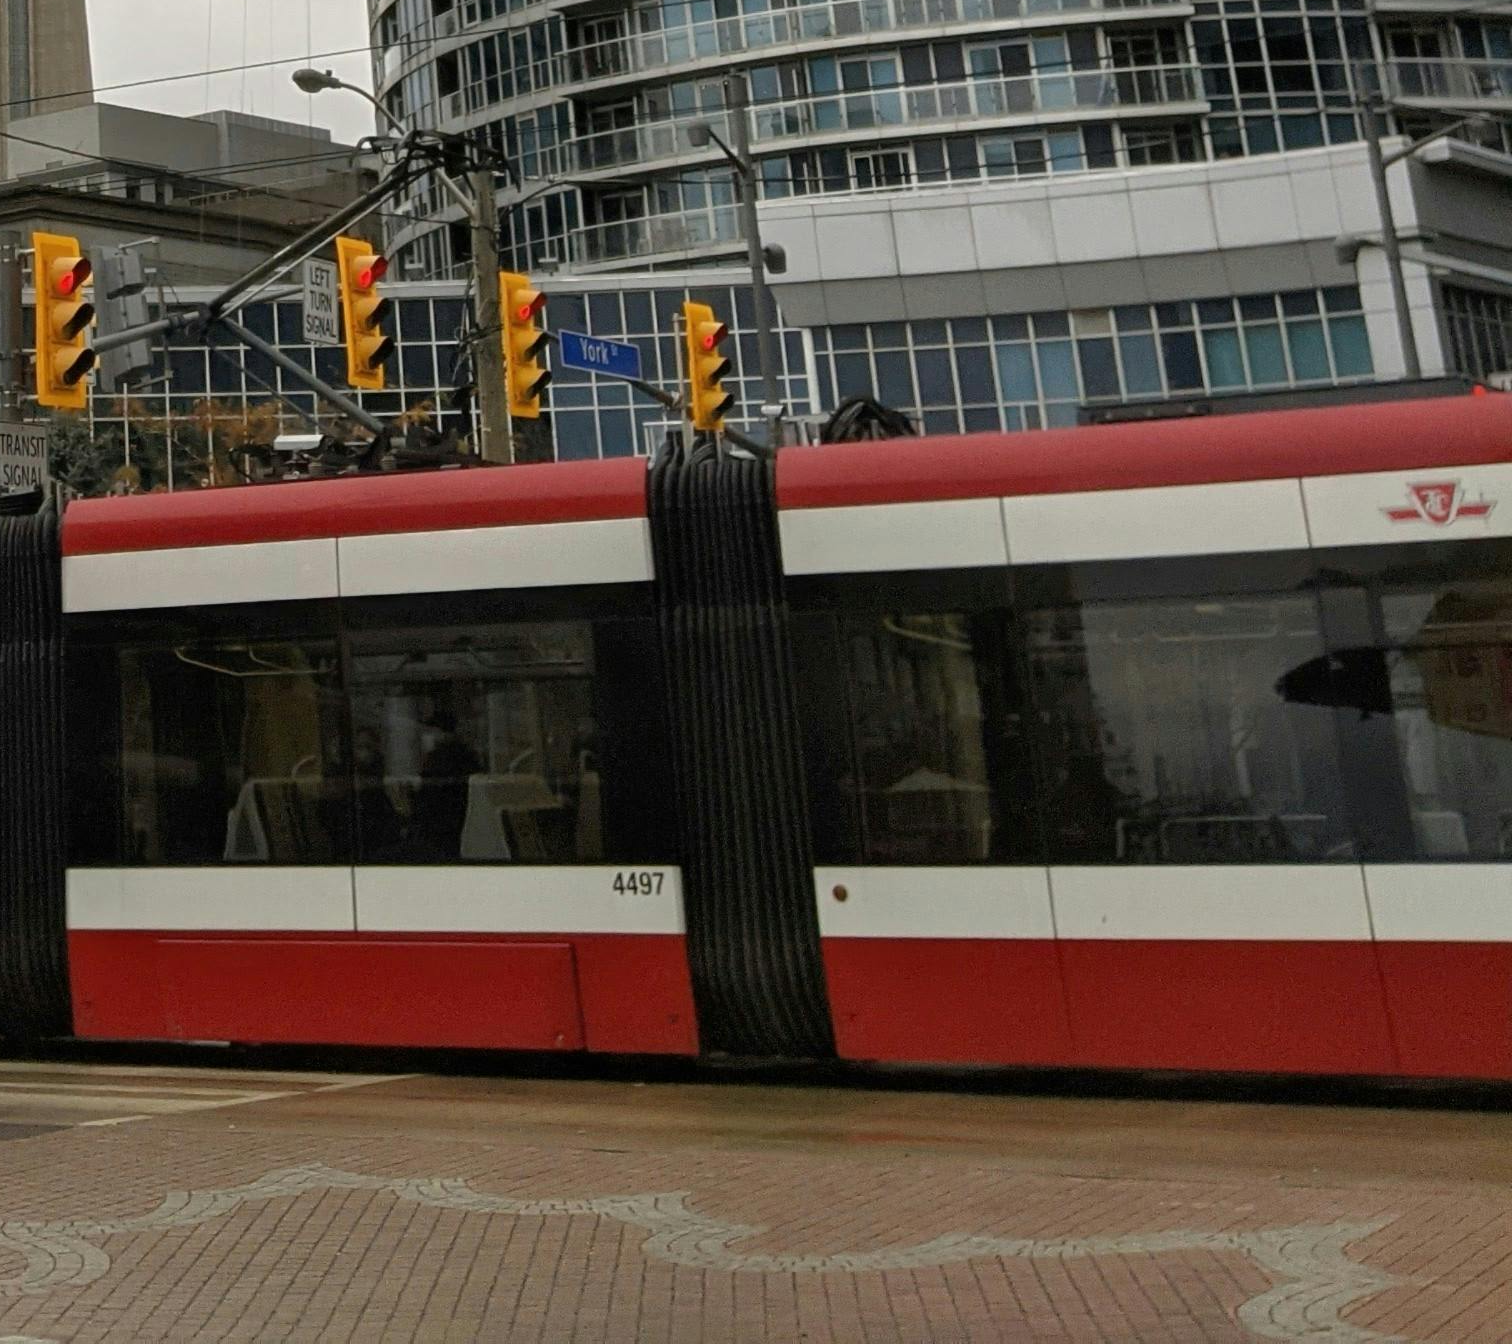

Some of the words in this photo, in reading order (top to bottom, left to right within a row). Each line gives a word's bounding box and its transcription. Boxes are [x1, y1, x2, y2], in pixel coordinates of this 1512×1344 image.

[309, 263, 331, 289] LEFT
[309, 290, 332, 313] TURN
[306, 314, 337, 338] SIGNAL
[579, 337, 609, 365] York
[0, 433, 46, 459] TRANSIT
[3, 463, 41, 487] SIGNAL
[612, 872, 664, 895] 4497
